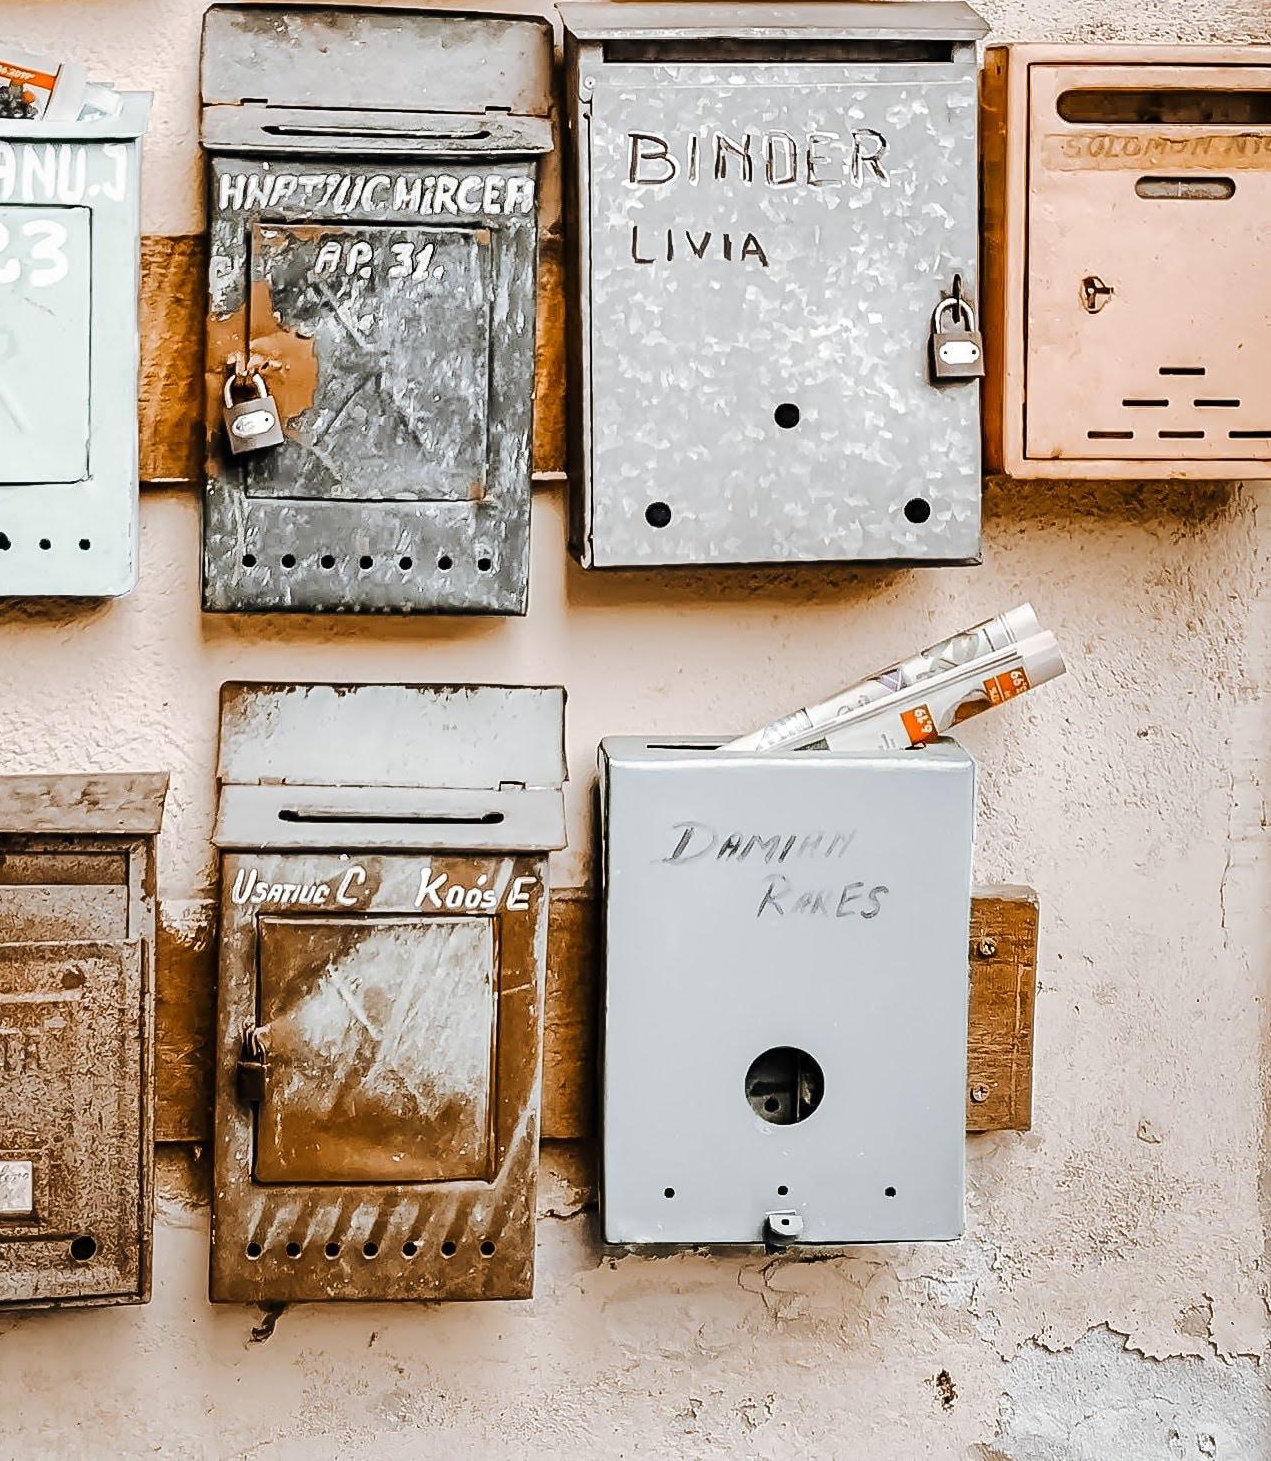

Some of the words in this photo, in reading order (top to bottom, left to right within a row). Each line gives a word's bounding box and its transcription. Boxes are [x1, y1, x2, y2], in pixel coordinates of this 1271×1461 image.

[624, 128, 891, 188] BINDER
[315, 241, 373, 279] AP.
[632, 225, 770, 268] LIVIA
[650, 821, 857, 865] DAMIAN
[507, 876, 537, 911] E
